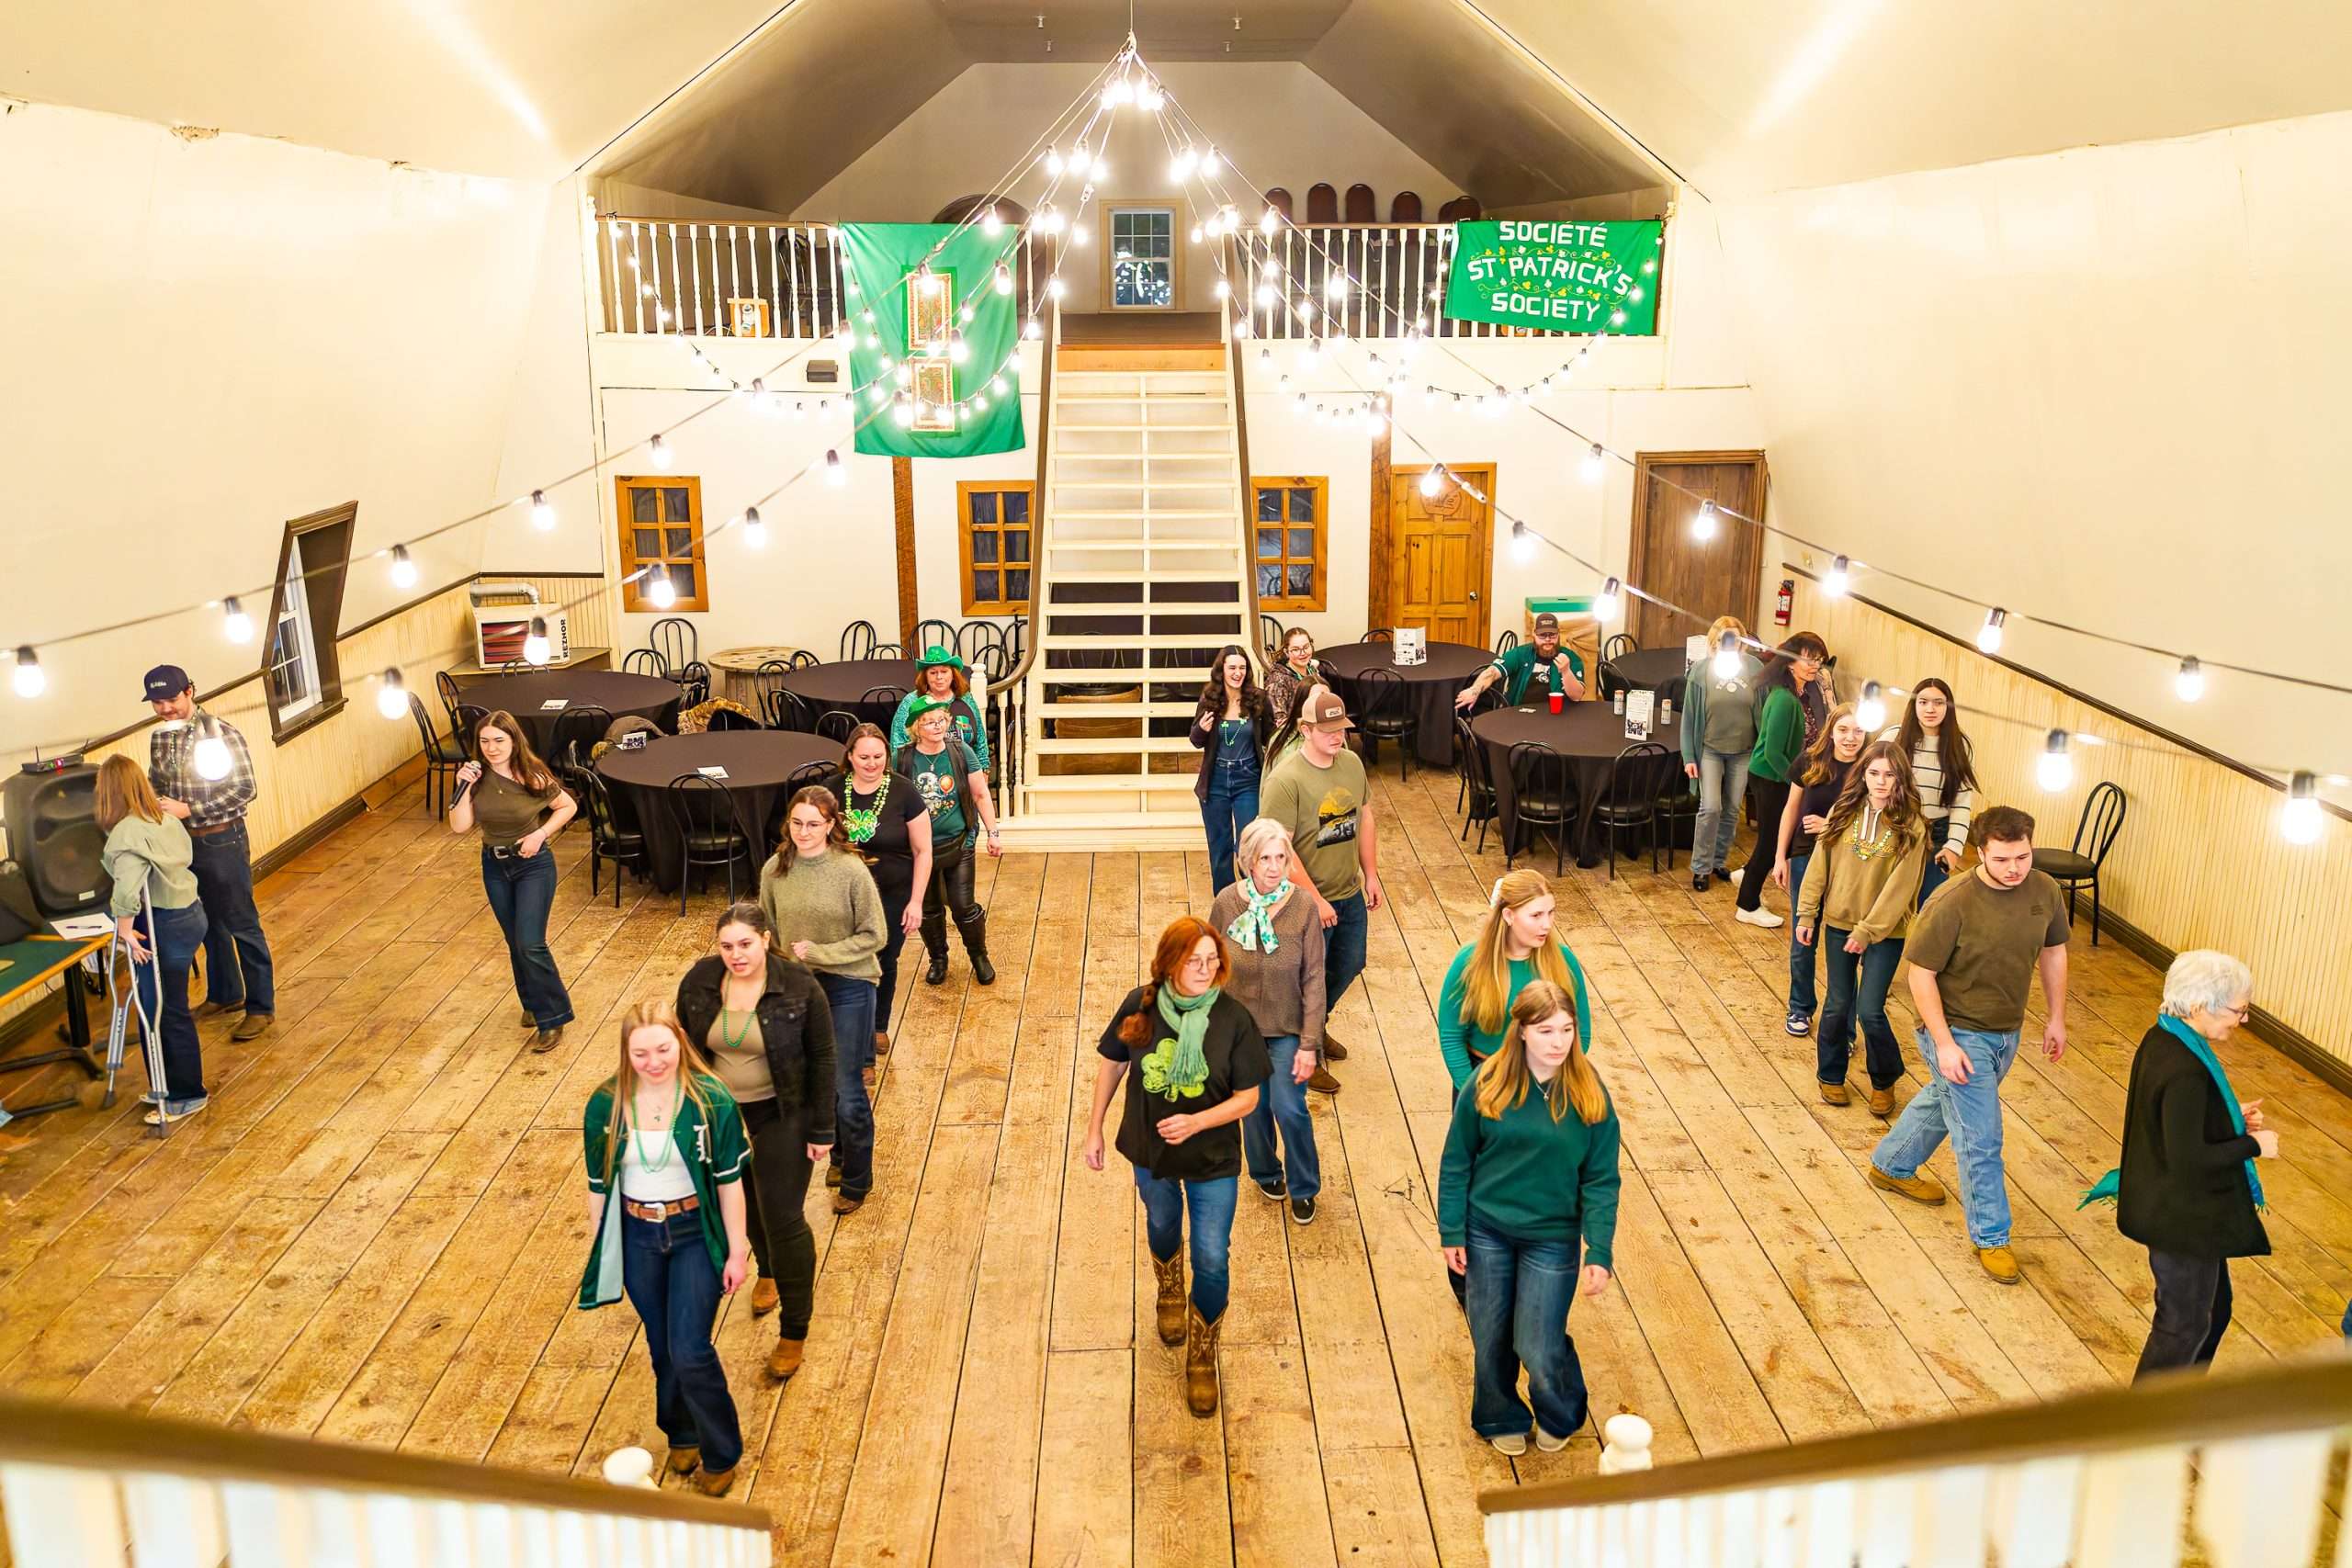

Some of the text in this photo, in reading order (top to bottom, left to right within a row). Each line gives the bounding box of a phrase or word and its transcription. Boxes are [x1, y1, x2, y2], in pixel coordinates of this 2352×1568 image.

[1498, 220, 1608, 248] SOCIÉTÉ
[1467, 256, 1634, 297] ST PATRICK'S
[1491, 292, 1600, 321] SOCIETY
[560, 618, 569, 658] REZNOR
